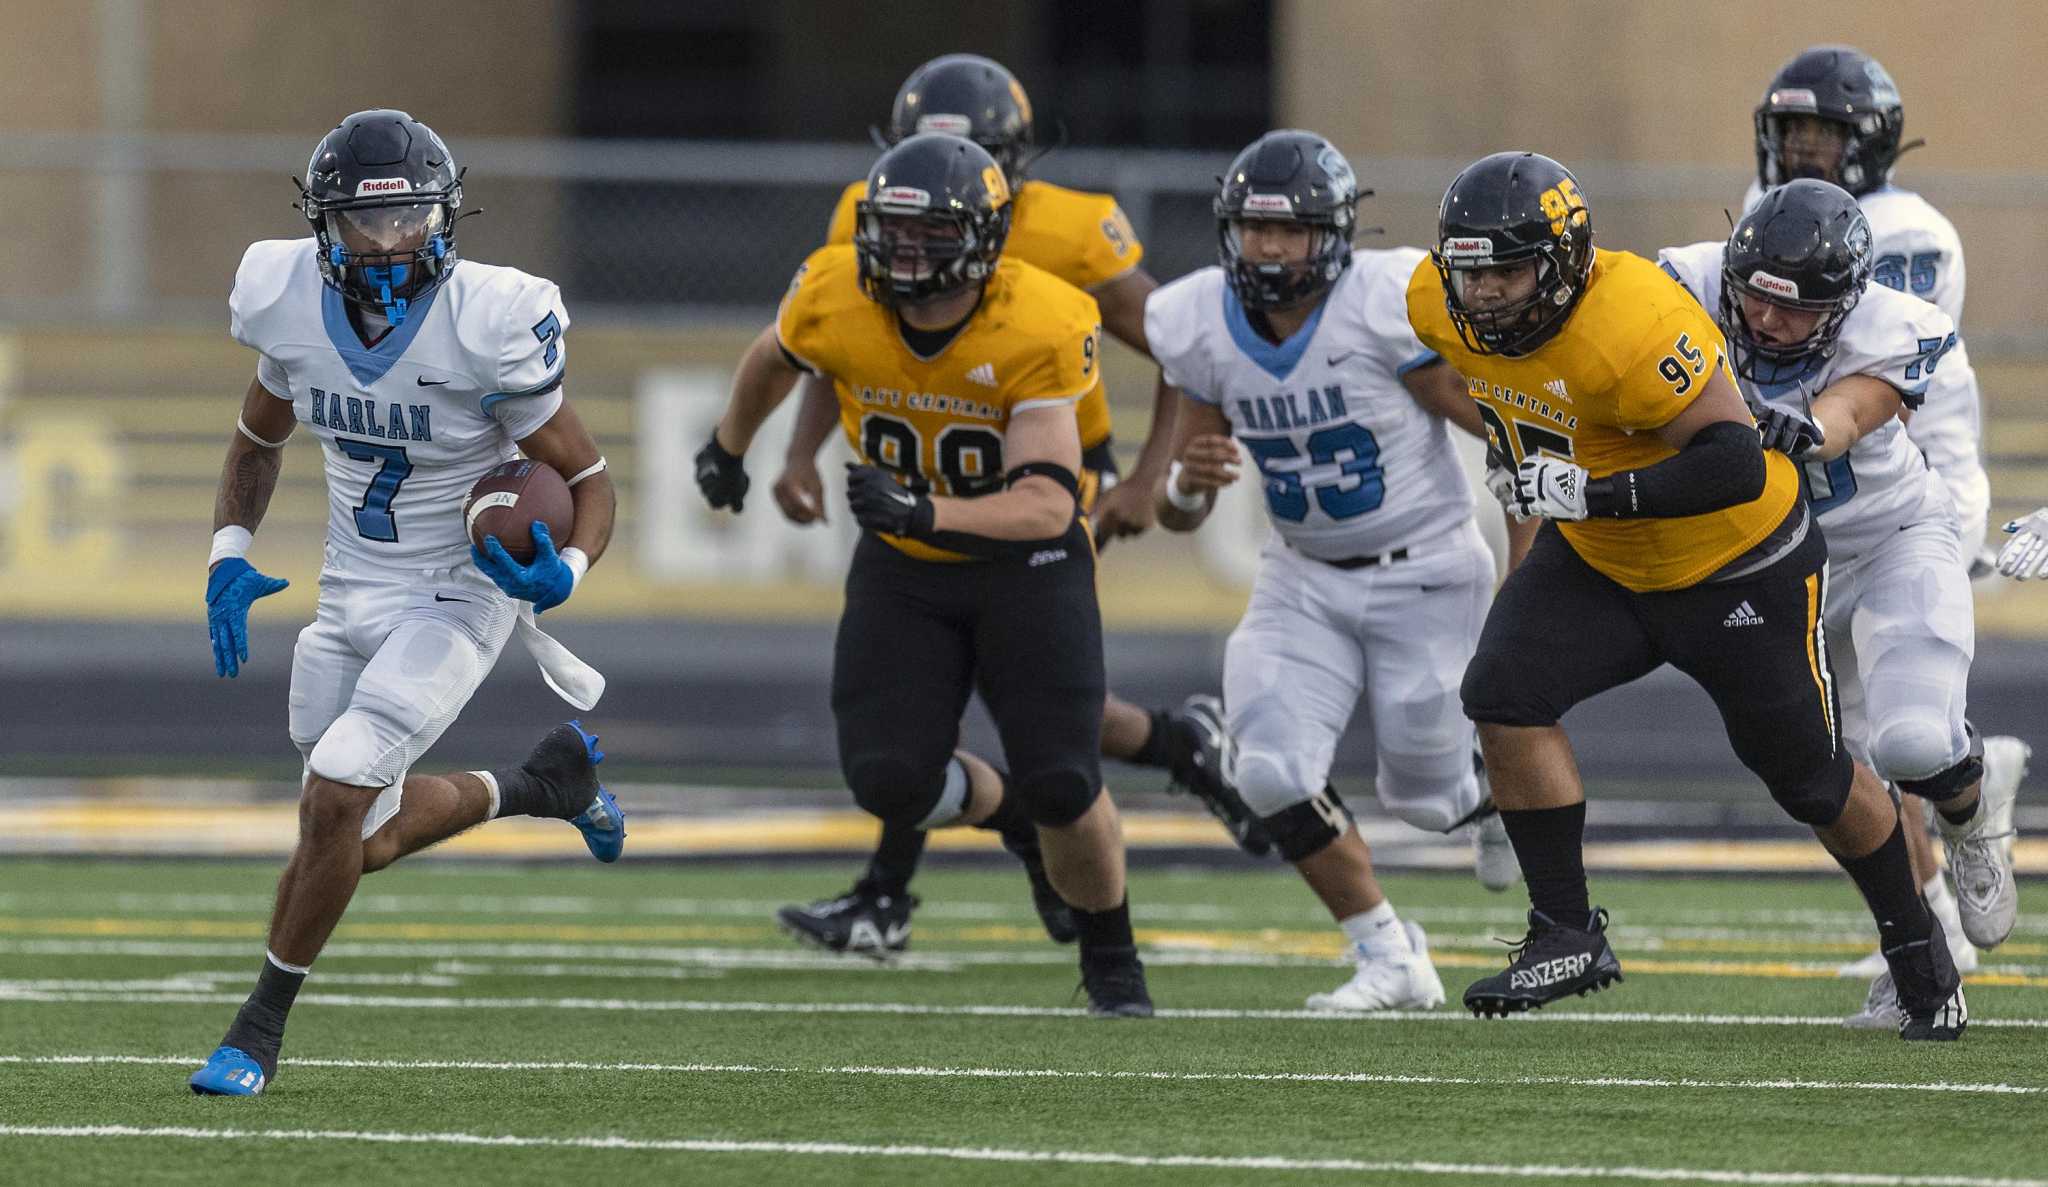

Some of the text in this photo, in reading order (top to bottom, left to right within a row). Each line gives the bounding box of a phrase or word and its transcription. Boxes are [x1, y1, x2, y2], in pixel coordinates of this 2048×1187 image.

[363, 180, 405, 192] Riddell
[531, 309, 562, 370] 7
[1657, 331, 1706, 396] 95
[310, 387, 432, 441] HARLAN
[1236, 383, 1347, 431] HARLAN
[1493, 384, 1579, 430] CENTRAL
[335, 436, 414, 543] 7
[1237, 420, 1386, 523] 53
[1723, 616, 1764, 628] adidas
